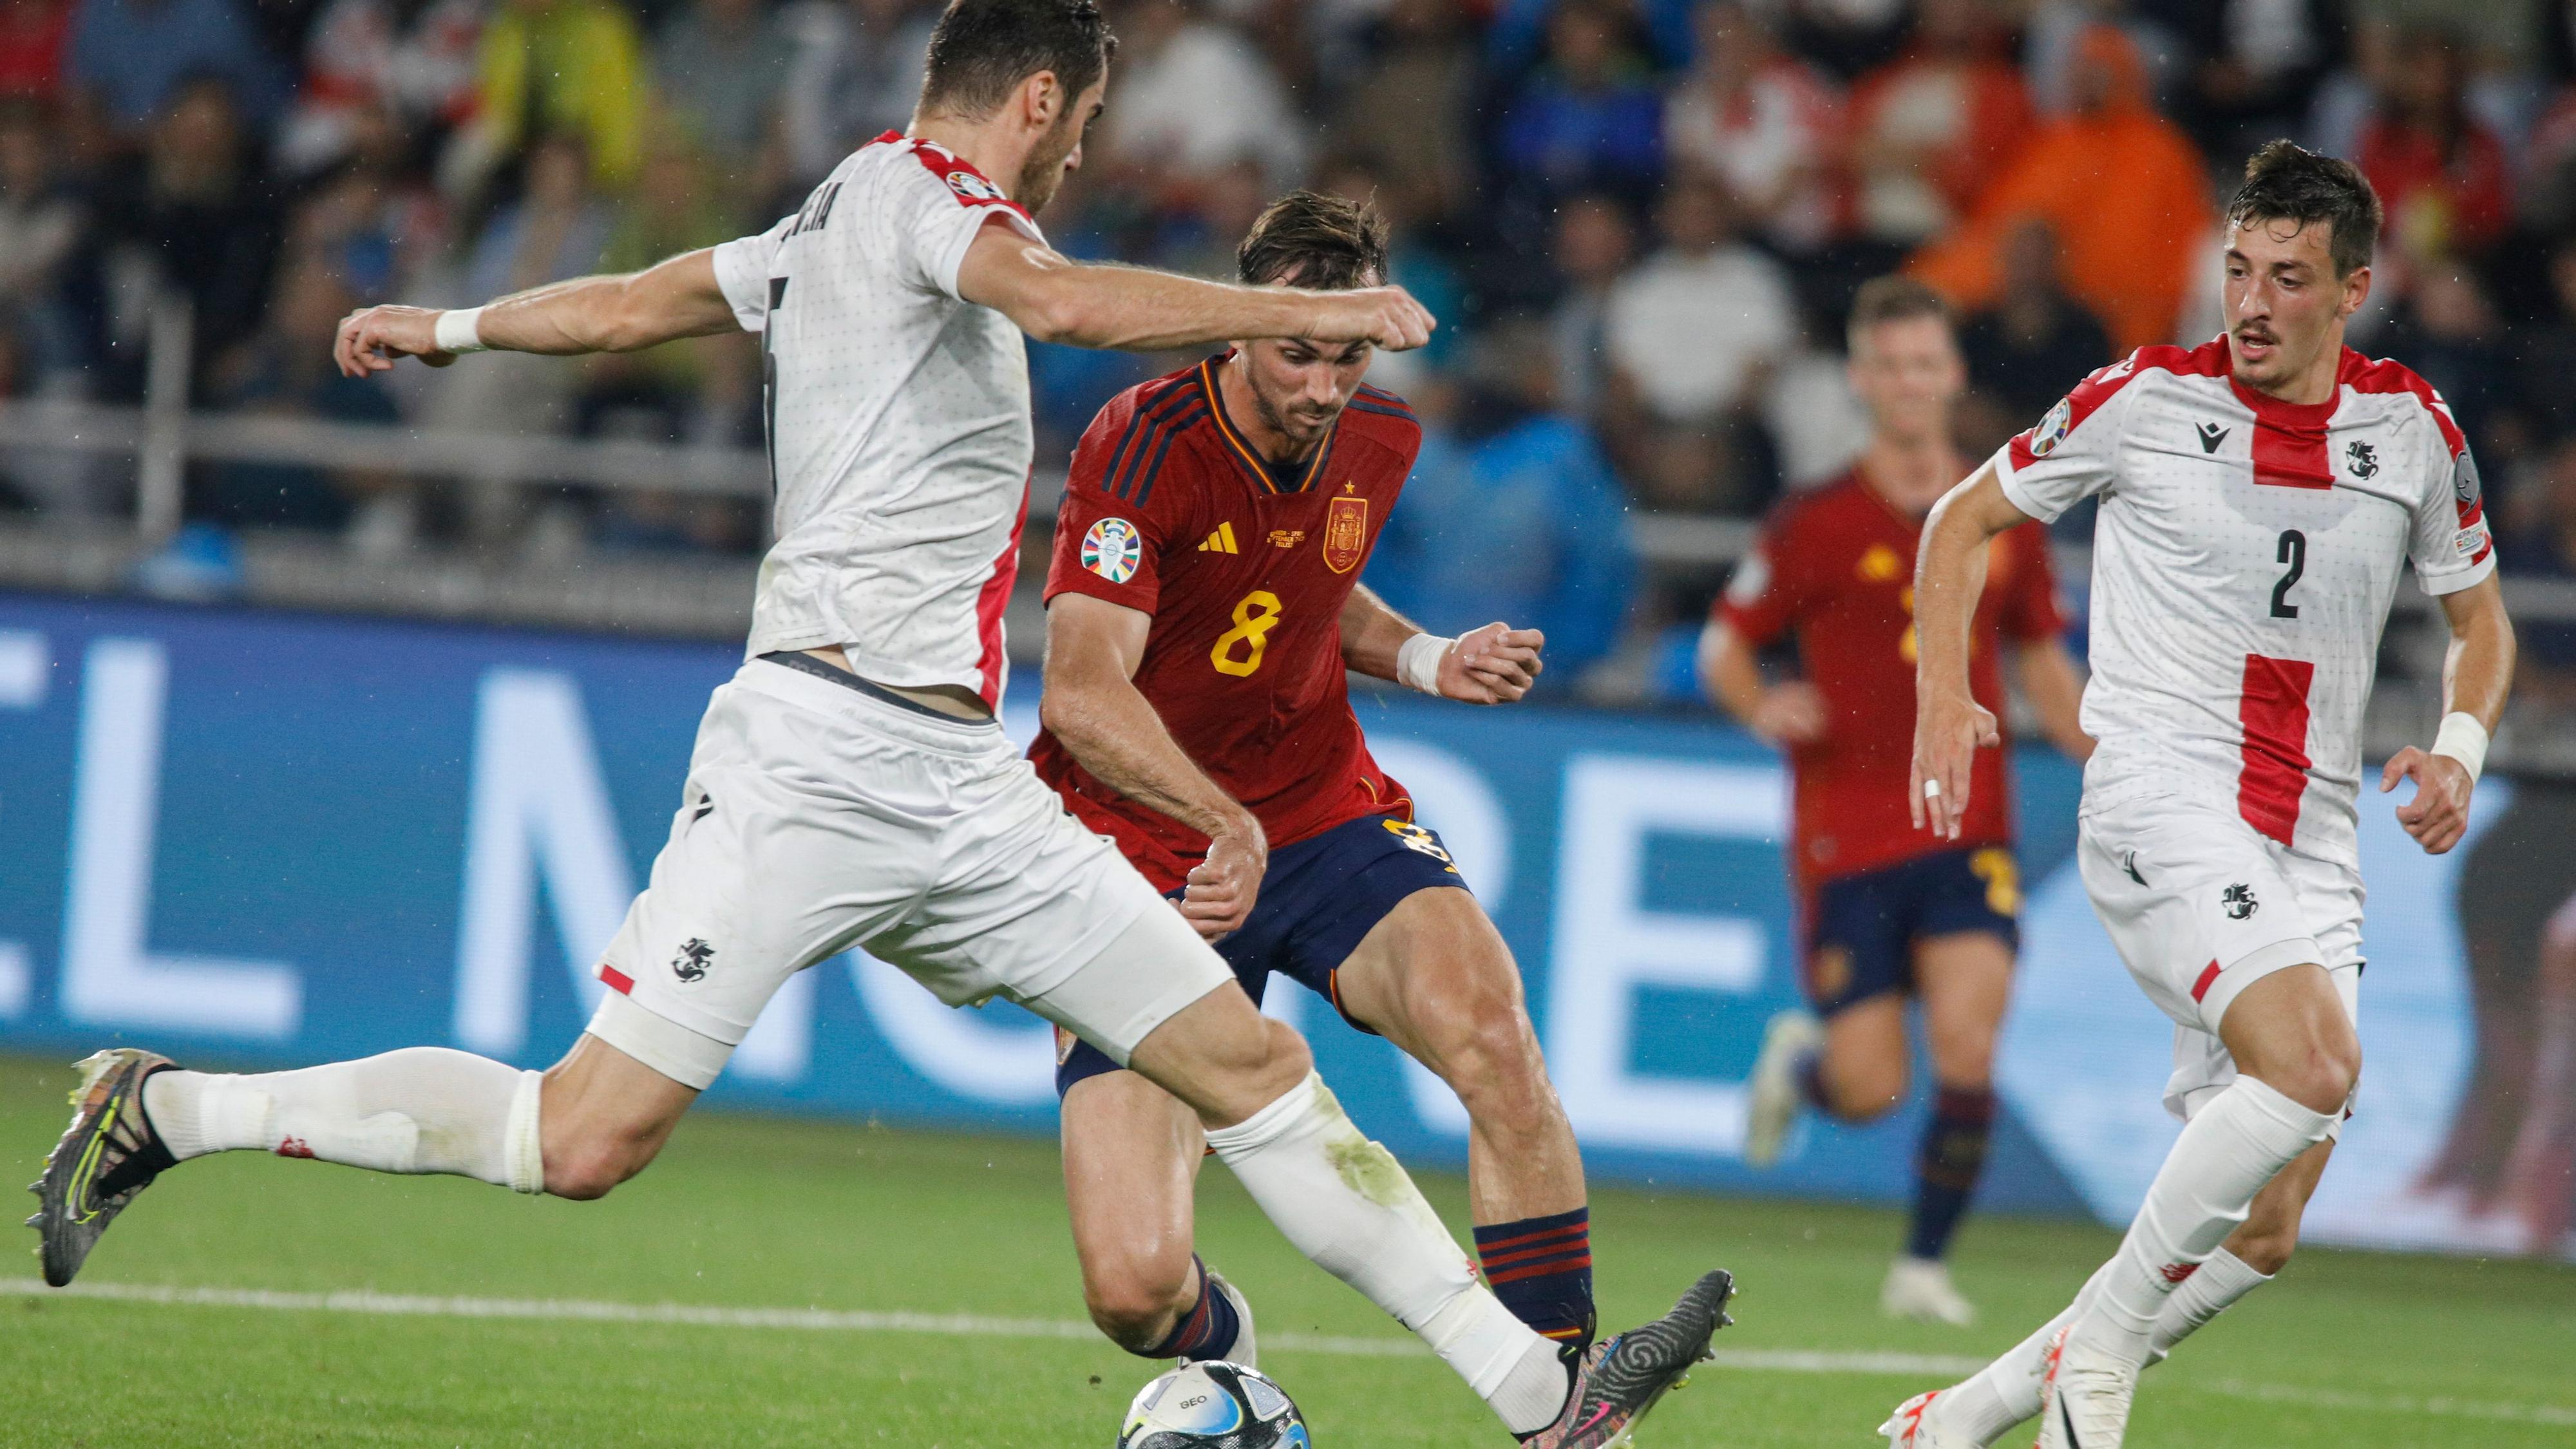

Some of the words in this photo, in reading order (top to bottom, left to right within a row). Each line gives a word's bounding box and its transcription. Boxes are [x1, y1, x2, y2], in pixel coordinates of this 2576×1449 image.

[2270, 529, 2306, 618] 2
[1210, 590, 1282, 677] 8
[1179, 1395, 1208, 1409] GEO
